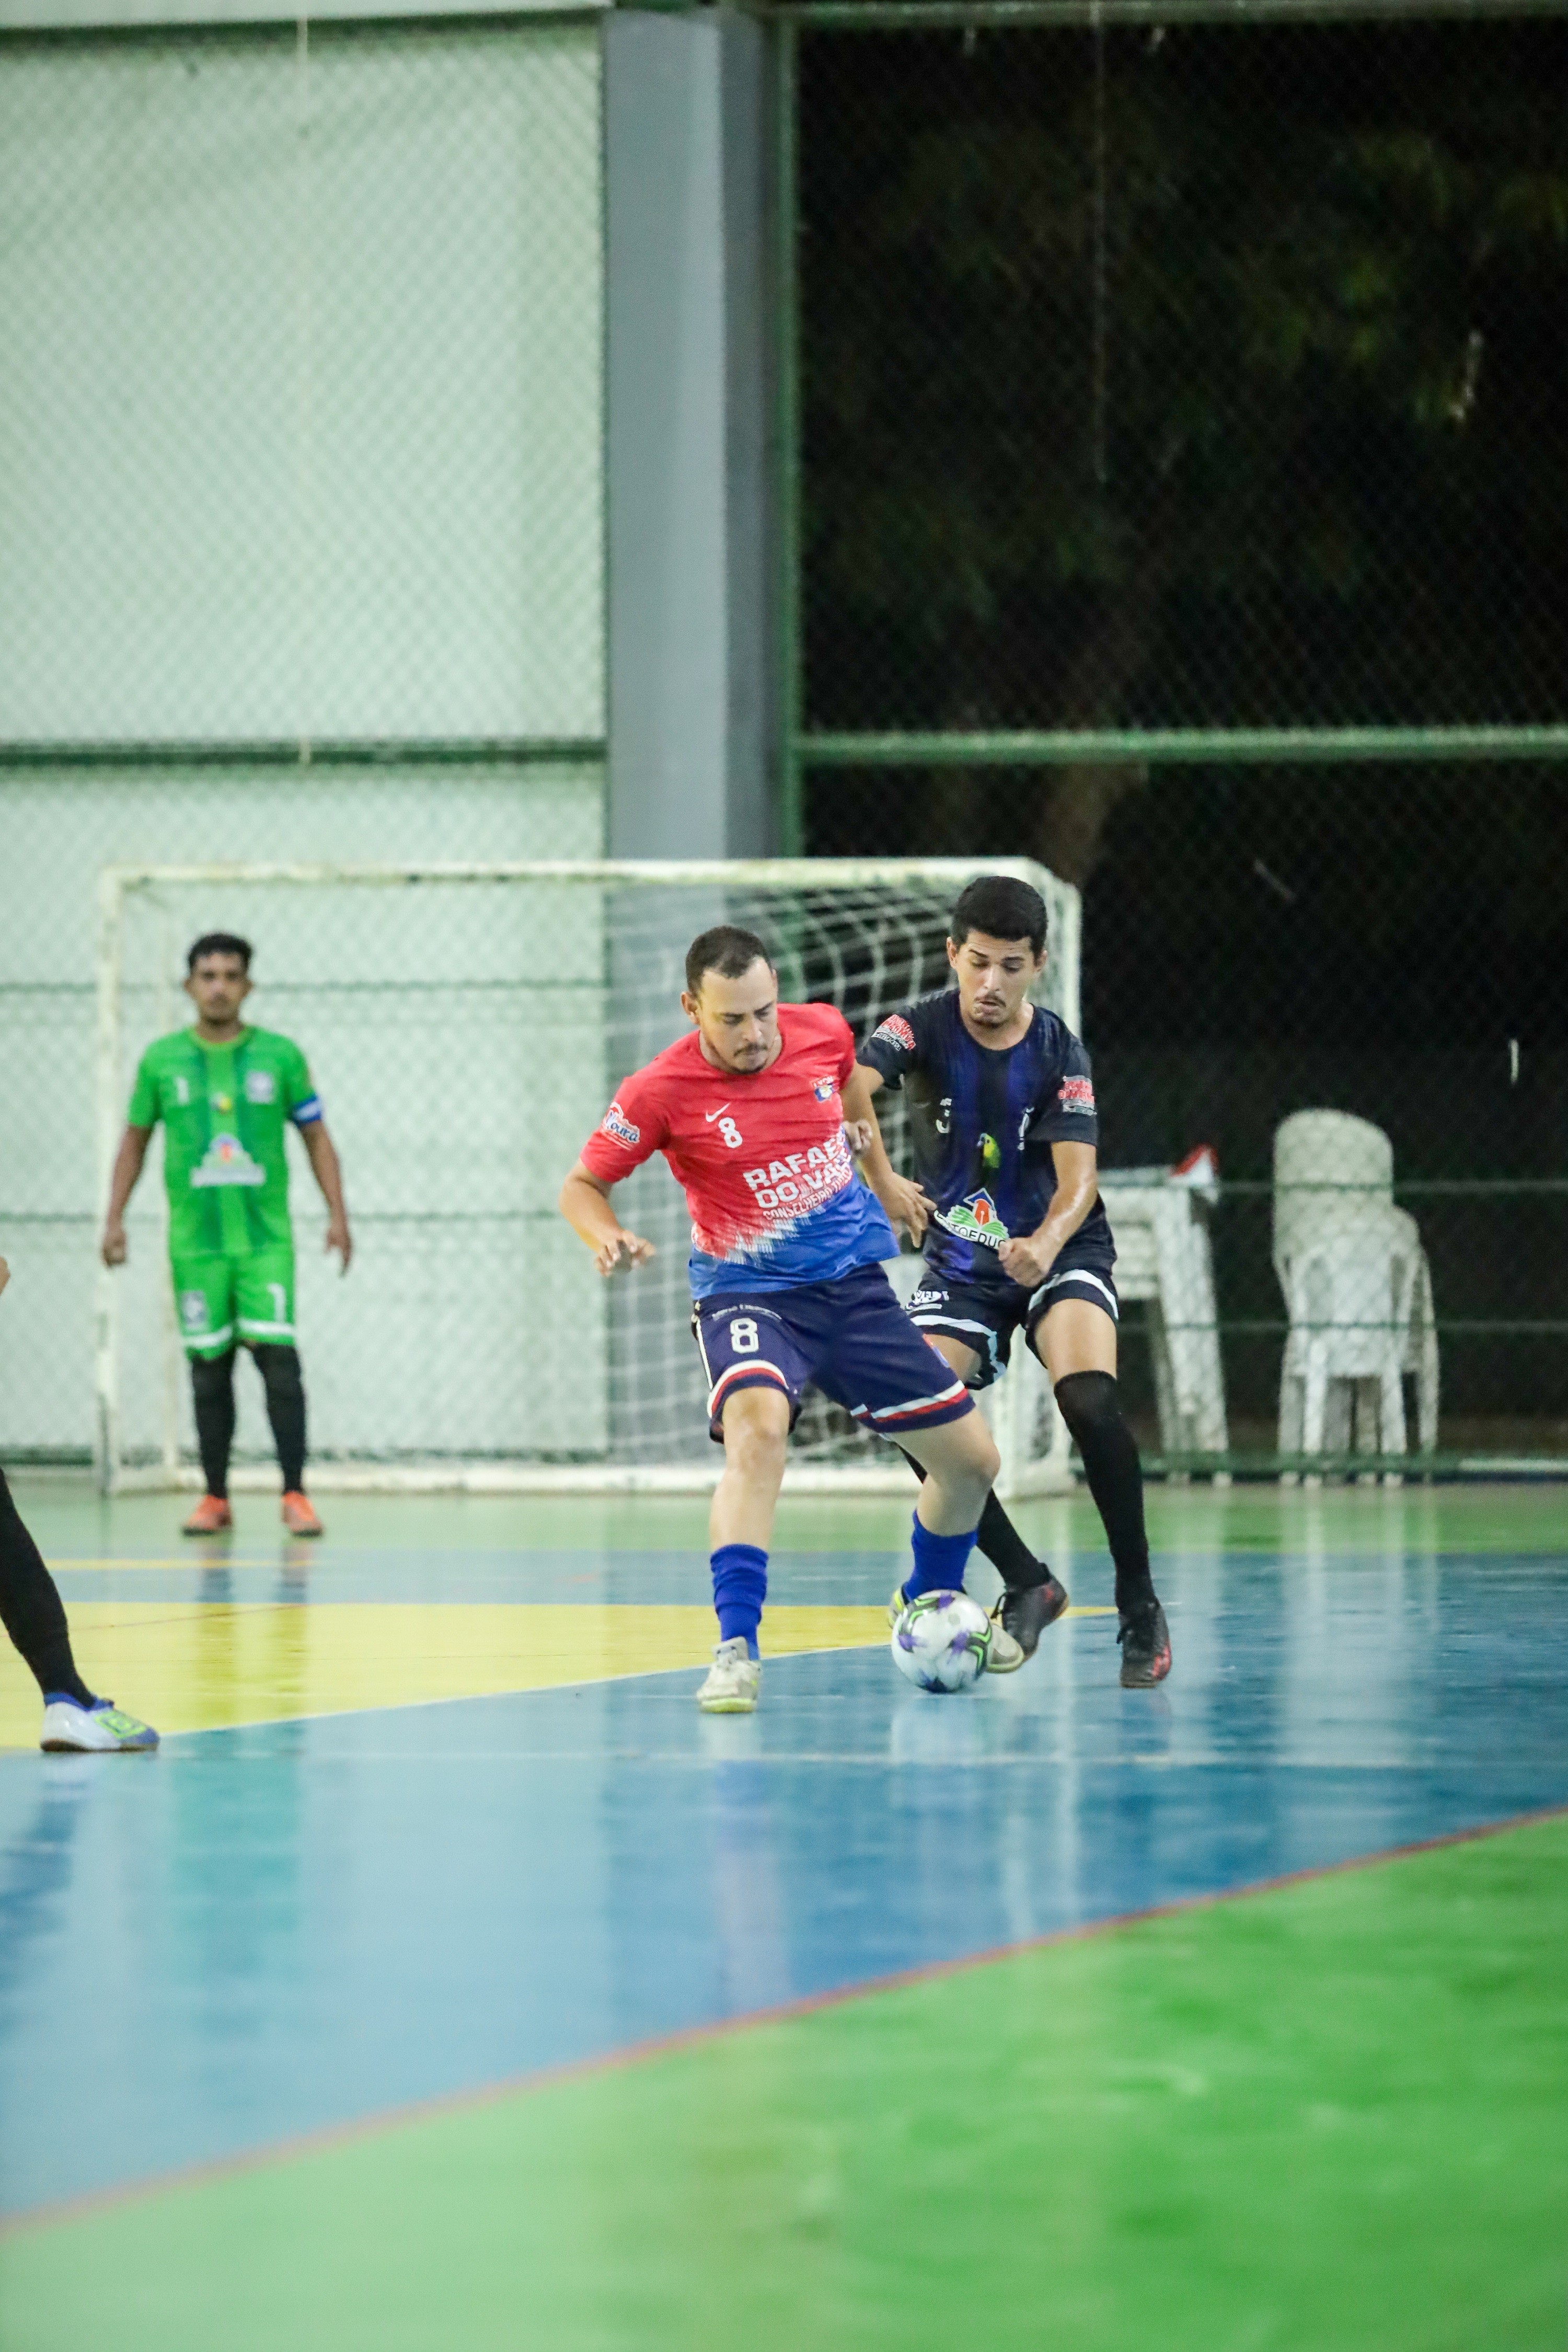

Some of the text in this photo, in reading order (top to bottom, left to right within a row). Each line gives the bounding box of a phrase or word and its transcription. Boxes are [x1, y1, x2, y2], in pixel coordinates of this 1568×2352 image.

[718, 1116, 743, 1149] 8
[755, 1182, 799, 1208] DO
[267, 1283, 286, 1323] 1
[730, 1317, 759, 1354] 8
